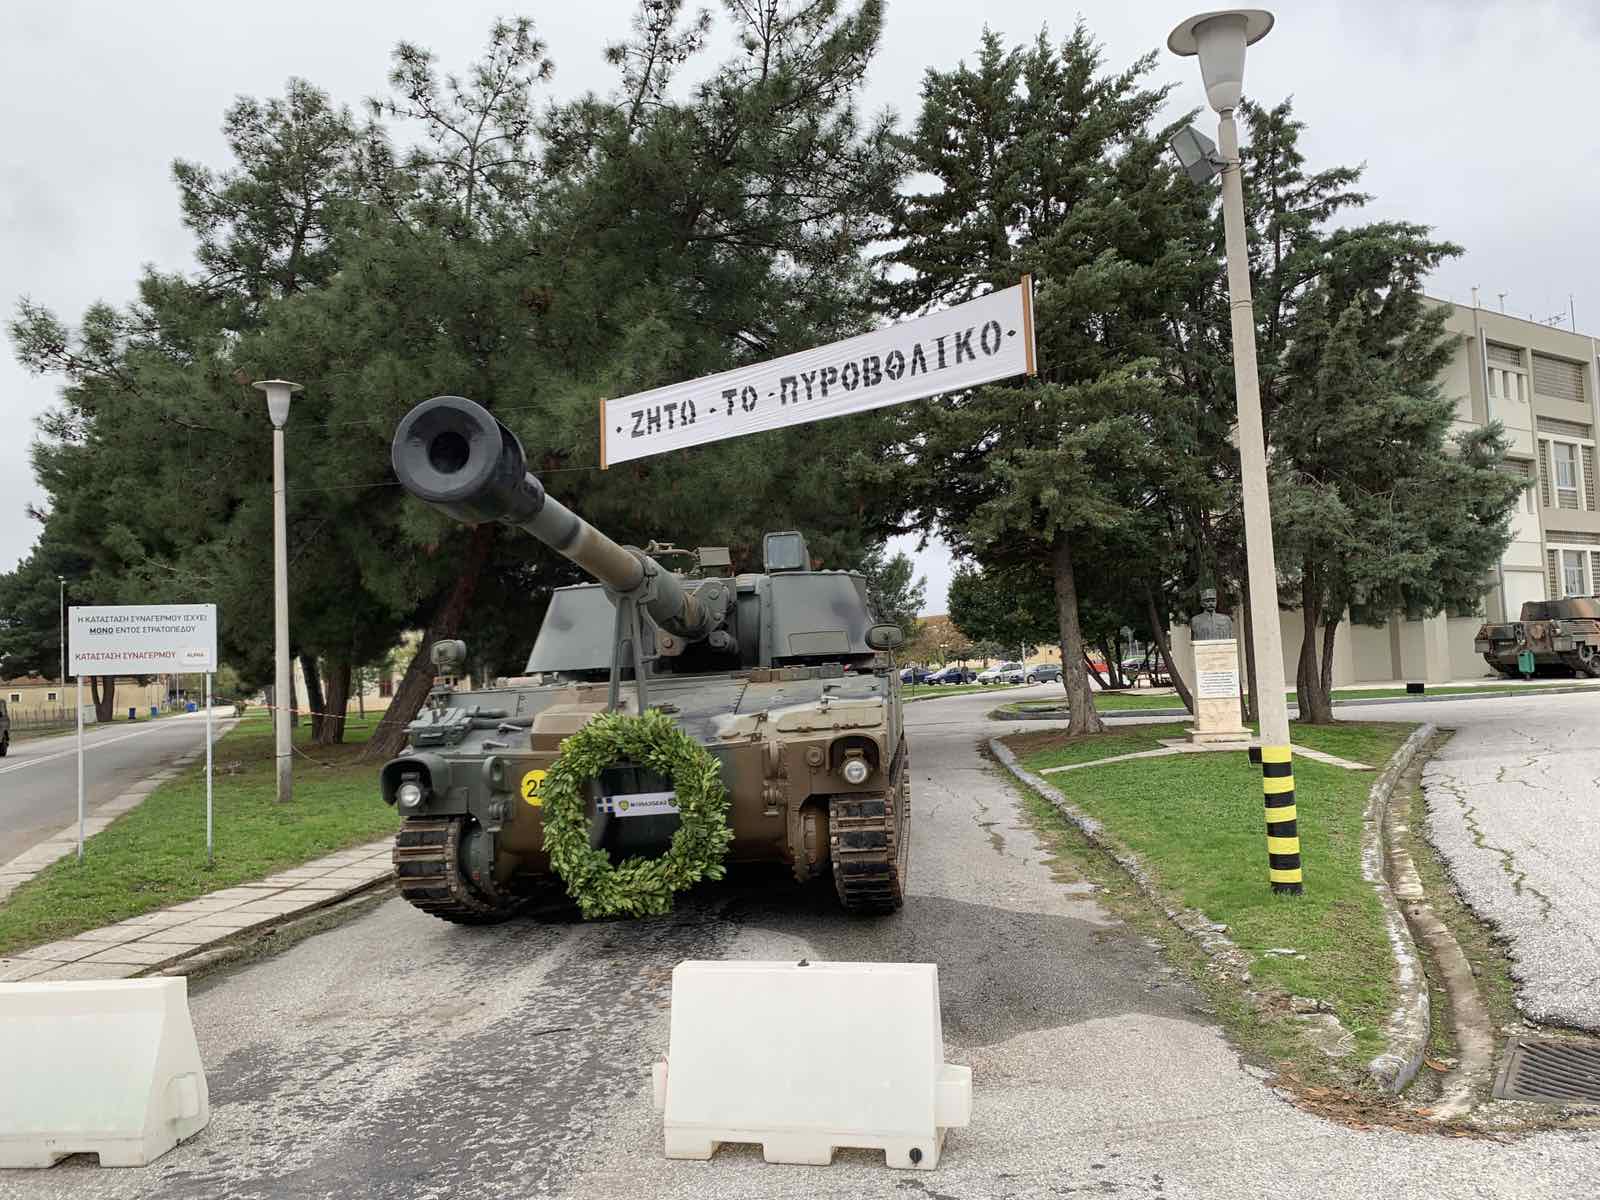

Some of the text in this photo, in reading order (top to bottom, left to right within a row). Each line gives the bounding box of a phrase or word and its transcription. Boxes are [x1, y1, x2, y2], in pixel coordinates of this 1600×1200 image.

[630, 399, 697, 439] ΖΗΤΩ
[721, 385, 758, 416] ΤΟ
[86, 615, 129, 623] ΚΑΤΑΣΤΑΣΗ
[130, 614, 182, 623] ΣΥΝΑΓΕΡΜΟΥ
[89, 625, 196, 635] ΜΟΝΟ ΕΝΤΟΣ ΣΤΡΑΤΟΠΕΔΟΥ
[75, 651, 176, 661] ΚΑΤΑΣΤΑΣΗ ΣΥΝΑΓΕΡΜΟΥ
